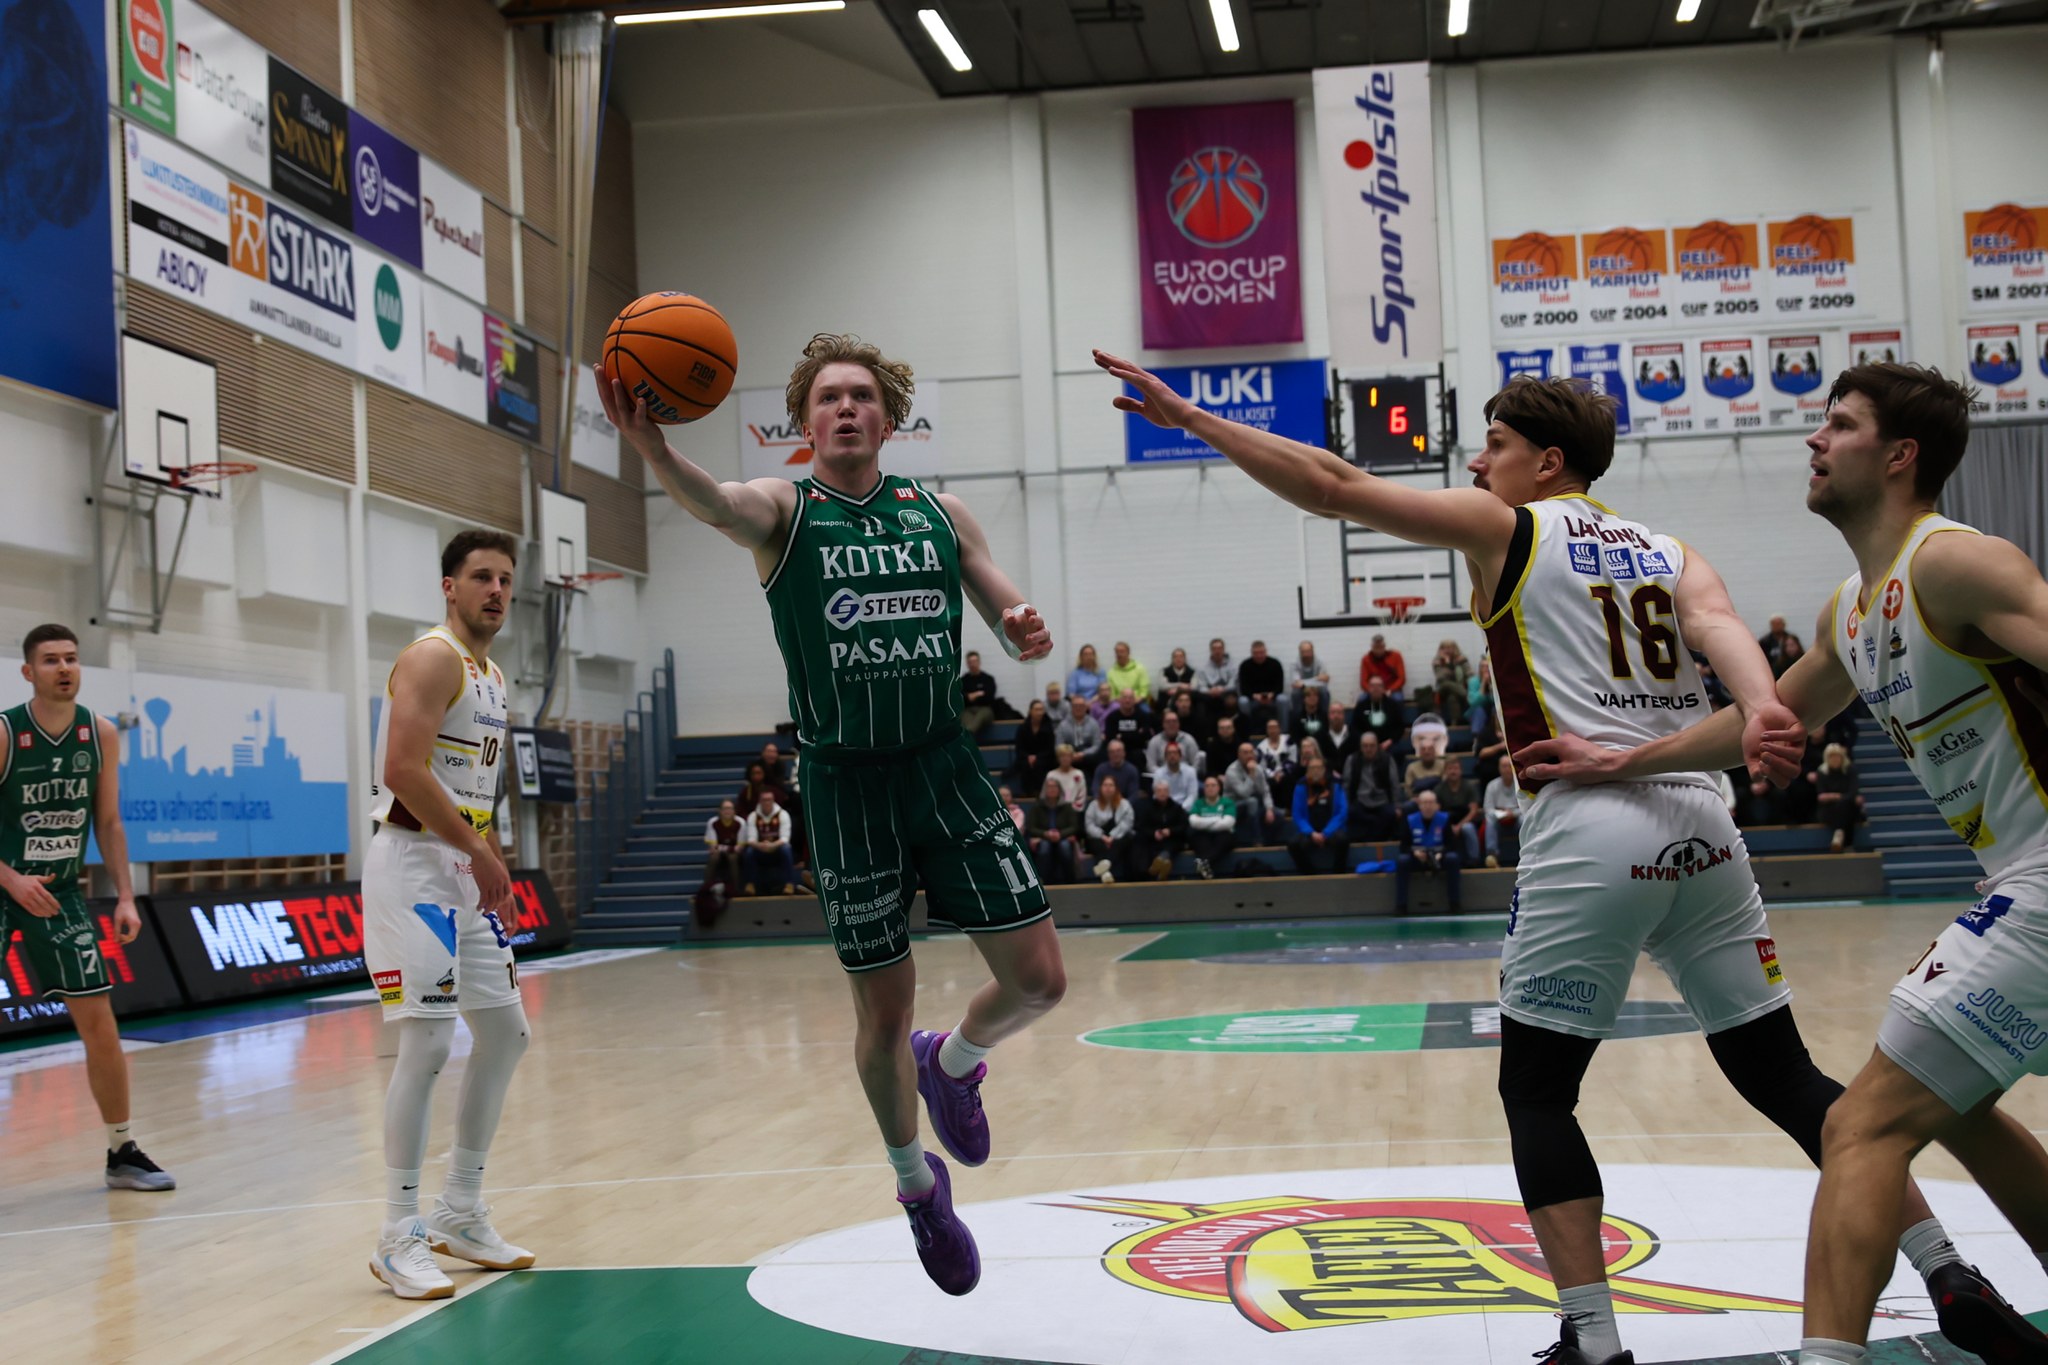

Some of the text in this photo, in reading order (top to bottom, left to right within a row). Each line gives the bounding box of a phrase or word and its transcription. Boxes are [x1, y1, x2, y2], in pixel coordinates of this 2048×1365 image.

[1355, 71, 1416, 358] Sportpiste
[270, 213, 354, 313] STARK
[1775, 260, 1847, 277] KARHUT
[1973, 251, 2045, 267] KARHUT
[157, 248, 208, 297] ABLOY
[1155, 256, 1287, 285] EUROCUP
[1590, 272, 1660, 288] KARHUT
[1680, 266, 1751, 282] KARHUT
[1164, 280, 1277, 306] WOMEN
[1500, 278, 1570, 293] KARHUT
[1972, 286, 2000, 301] SM
[1623, 304, 1668, 320] 2004
[1714, 300, 1759, 315] 2005
[1809, 294, 1855, 310] 2009
[1533, 310, 1578, 326] 2000
[1390, 406, 1408, 434] 6
[1412, 435, 1426, 453] 4
[860, 516, 886, 537] 11
[819, 540, 943, 580] KOTKA
[1575, 564, 1598, 573] YARA
[1644, 566, 1669, 574] YARA
[864, 595, 941, 617] STEVECO
[1587, 582, 1679, 681] 16
[844, 664, 952, 684] KAUPPAKESKUS
[1593, 692, 1700, 710] VAHTERUS
[480, 734, 499, 768] 10
[1927, 727, 1980, 762] SEGER
[52, 757, 63, 773] 7
[444, 755, 465, 768] VSP
[22, 777, 89, 805] KOTKA
[999, 851, 1039, 895] 11
[842, 901, 874, 915] KYMEN
[839, 922, 904, 951] jakosport.fi
[81, 948, 98, 974] 7
[1522, 974, 1598, 1004] JUKU
[1967, 988, 2048, 1051] JUKU
[1150, 1207, 1346, 1281] THE ORIGINAL
[1277, 1219, 1563, 1321] TAFFEL
